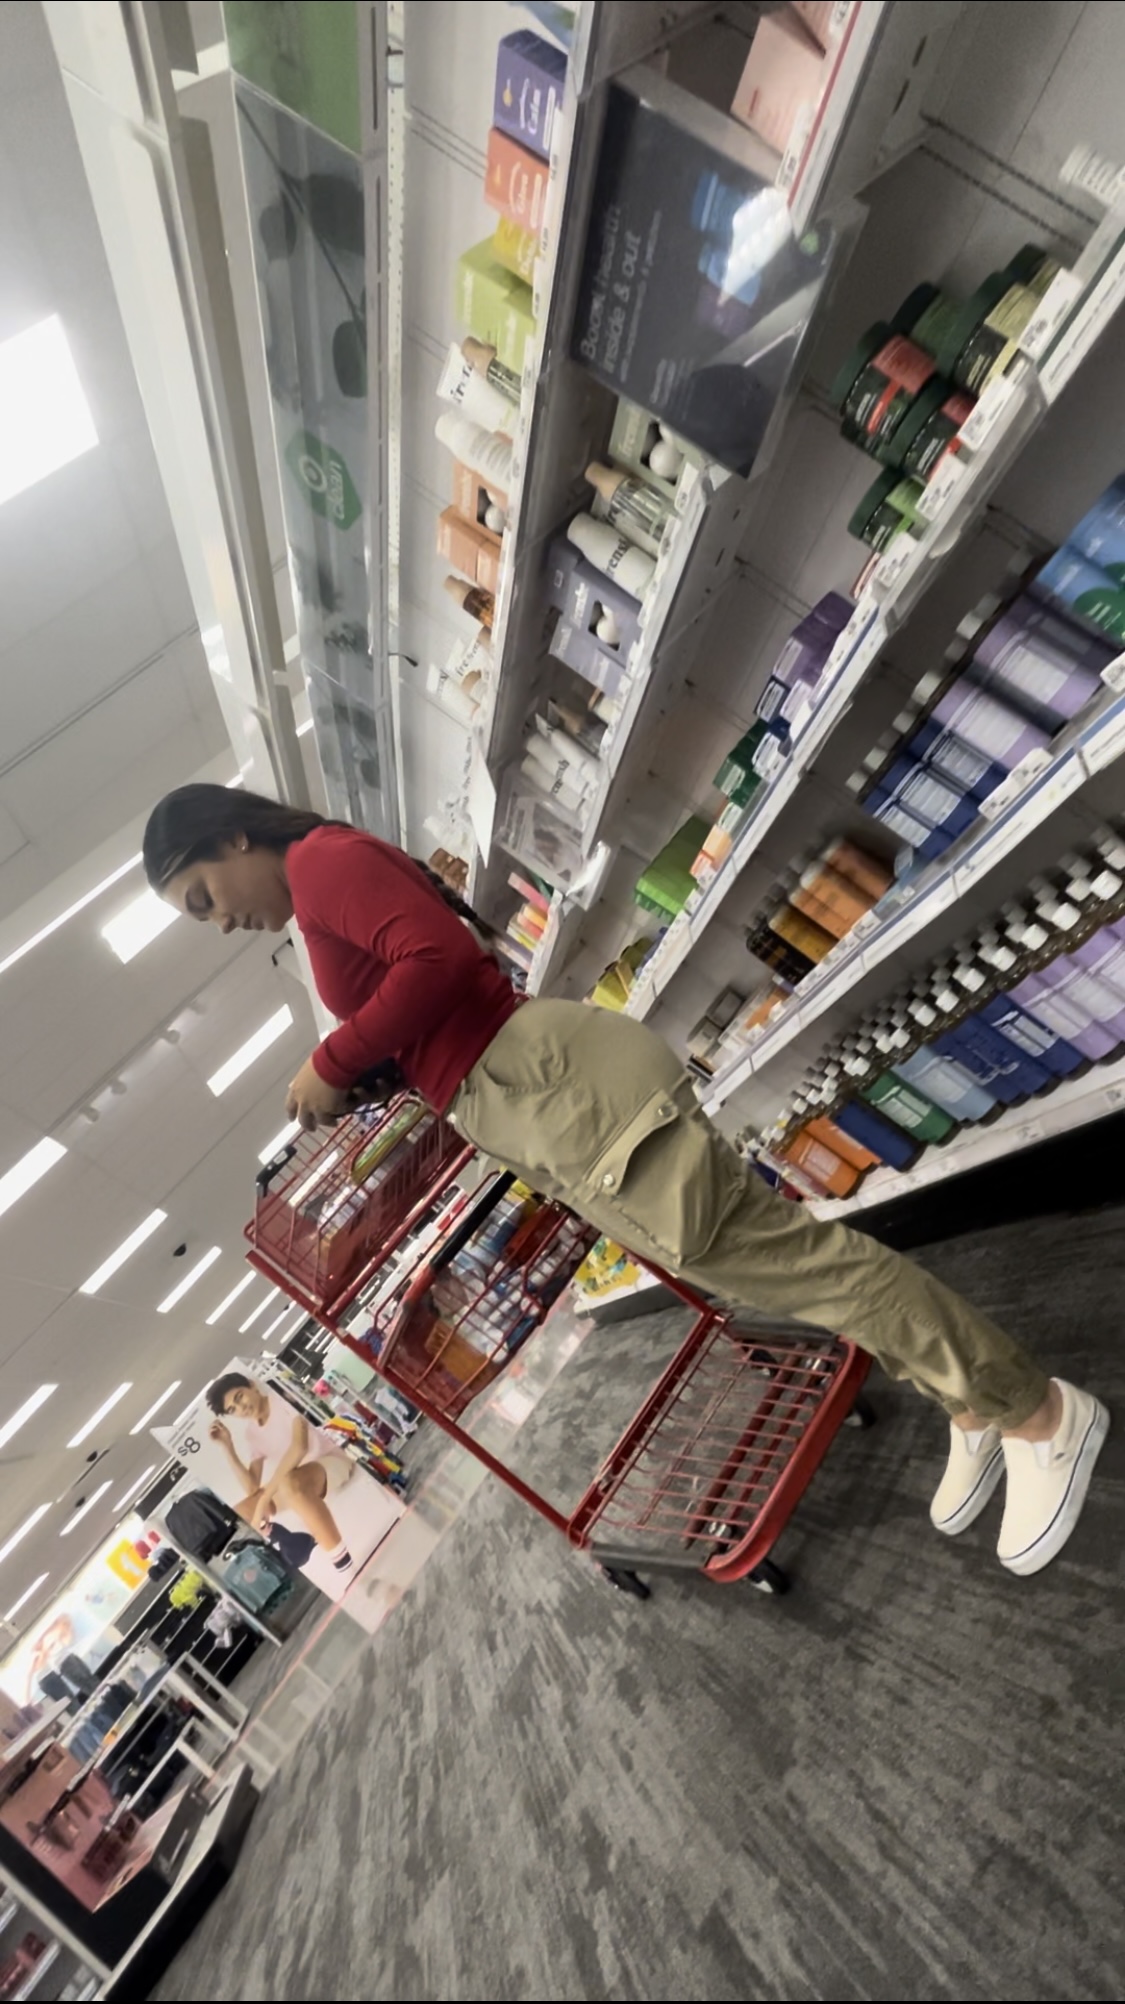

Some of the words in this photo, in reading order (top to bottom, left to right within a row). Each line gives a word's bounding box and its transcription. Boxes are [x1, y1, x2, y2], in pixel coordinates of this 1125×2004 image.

[527, 88, 542, 136] Calm
[622, 229, 642, 278] out
[613, 282, 631, 303] &
[580, 290, 606, 360] Boost
[602, 306, 626, 374] inside
